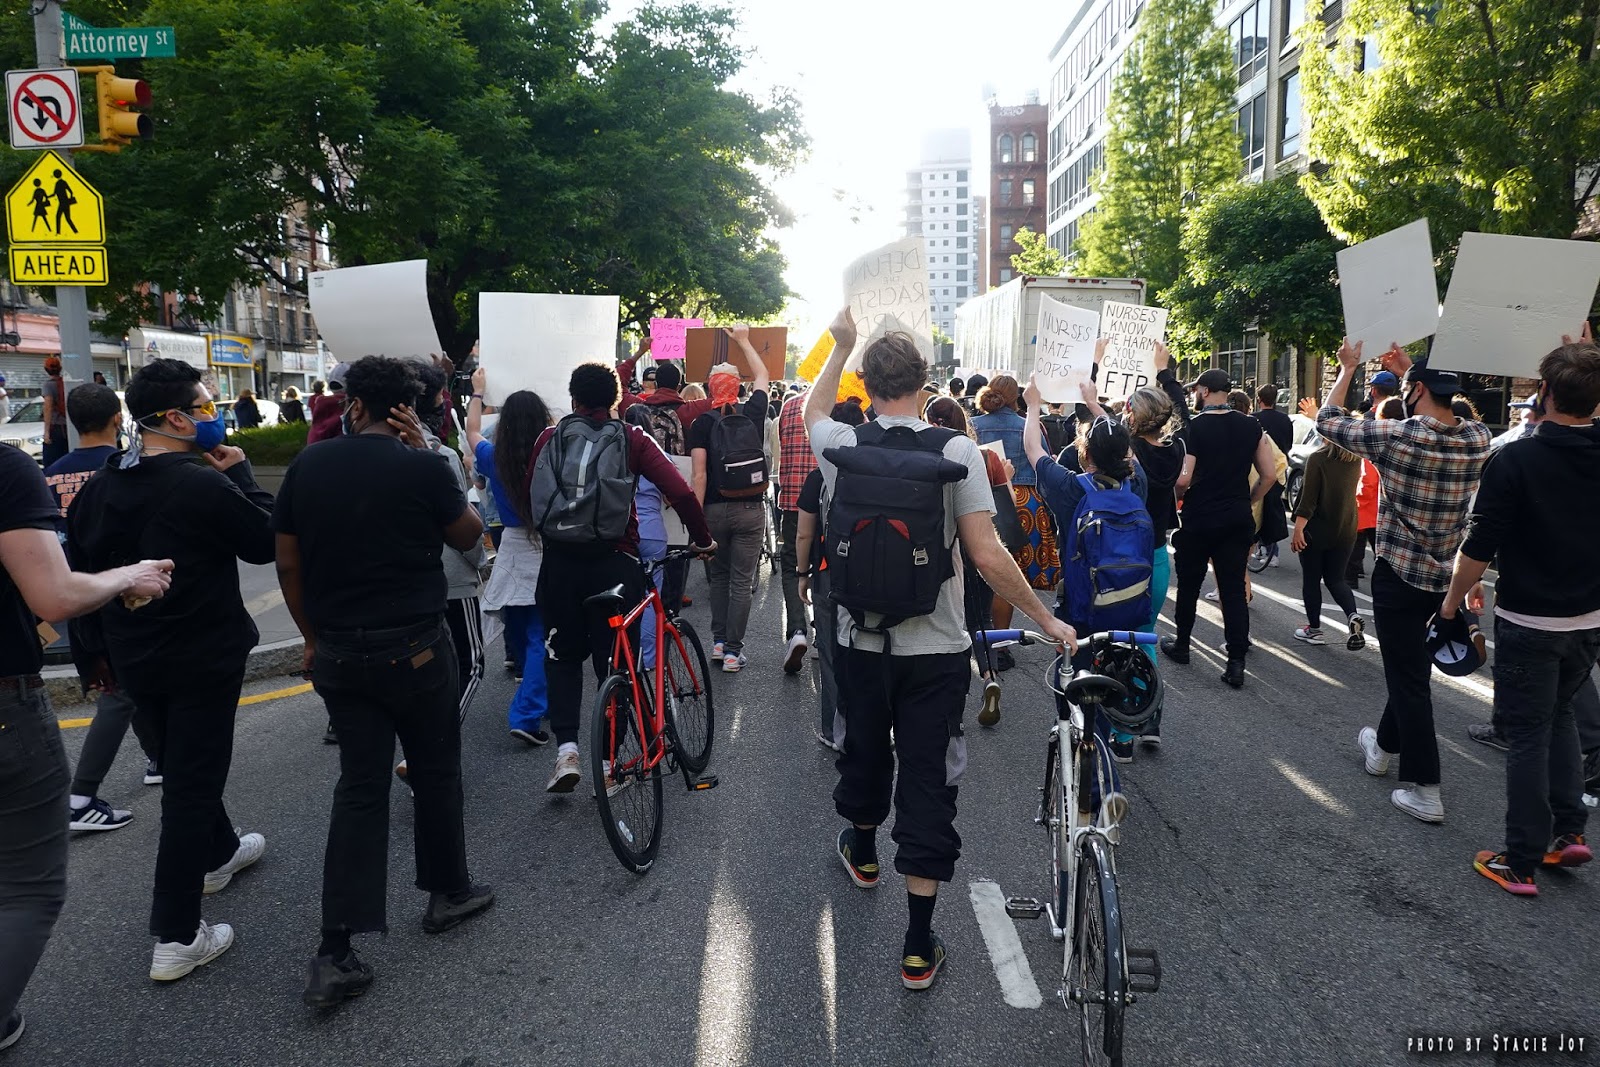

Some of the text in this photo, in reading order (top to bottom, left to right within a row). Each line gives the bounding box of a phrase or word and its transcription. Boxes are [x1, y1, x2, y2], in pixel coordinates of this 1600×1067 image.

[70, 30, 168, 57] Attorney St
[23, 255, 96, 275] AHEAD
[1106, 304, 1159, 323] NURSES
[1043, 311, 1092, 342] NURSES
[1110, 319, 1148, 336] KNOW
[1042, 336, 1074, 359] HATE
[1102, 332, 1157, 351] THE HARM
[1103, 355, 1143, 372] CAUSE
[1114, 347, 1136, 360] YOU
[1037, 357, 1072, 378] COPS
[1104, 371, 1148, 395] FTP
